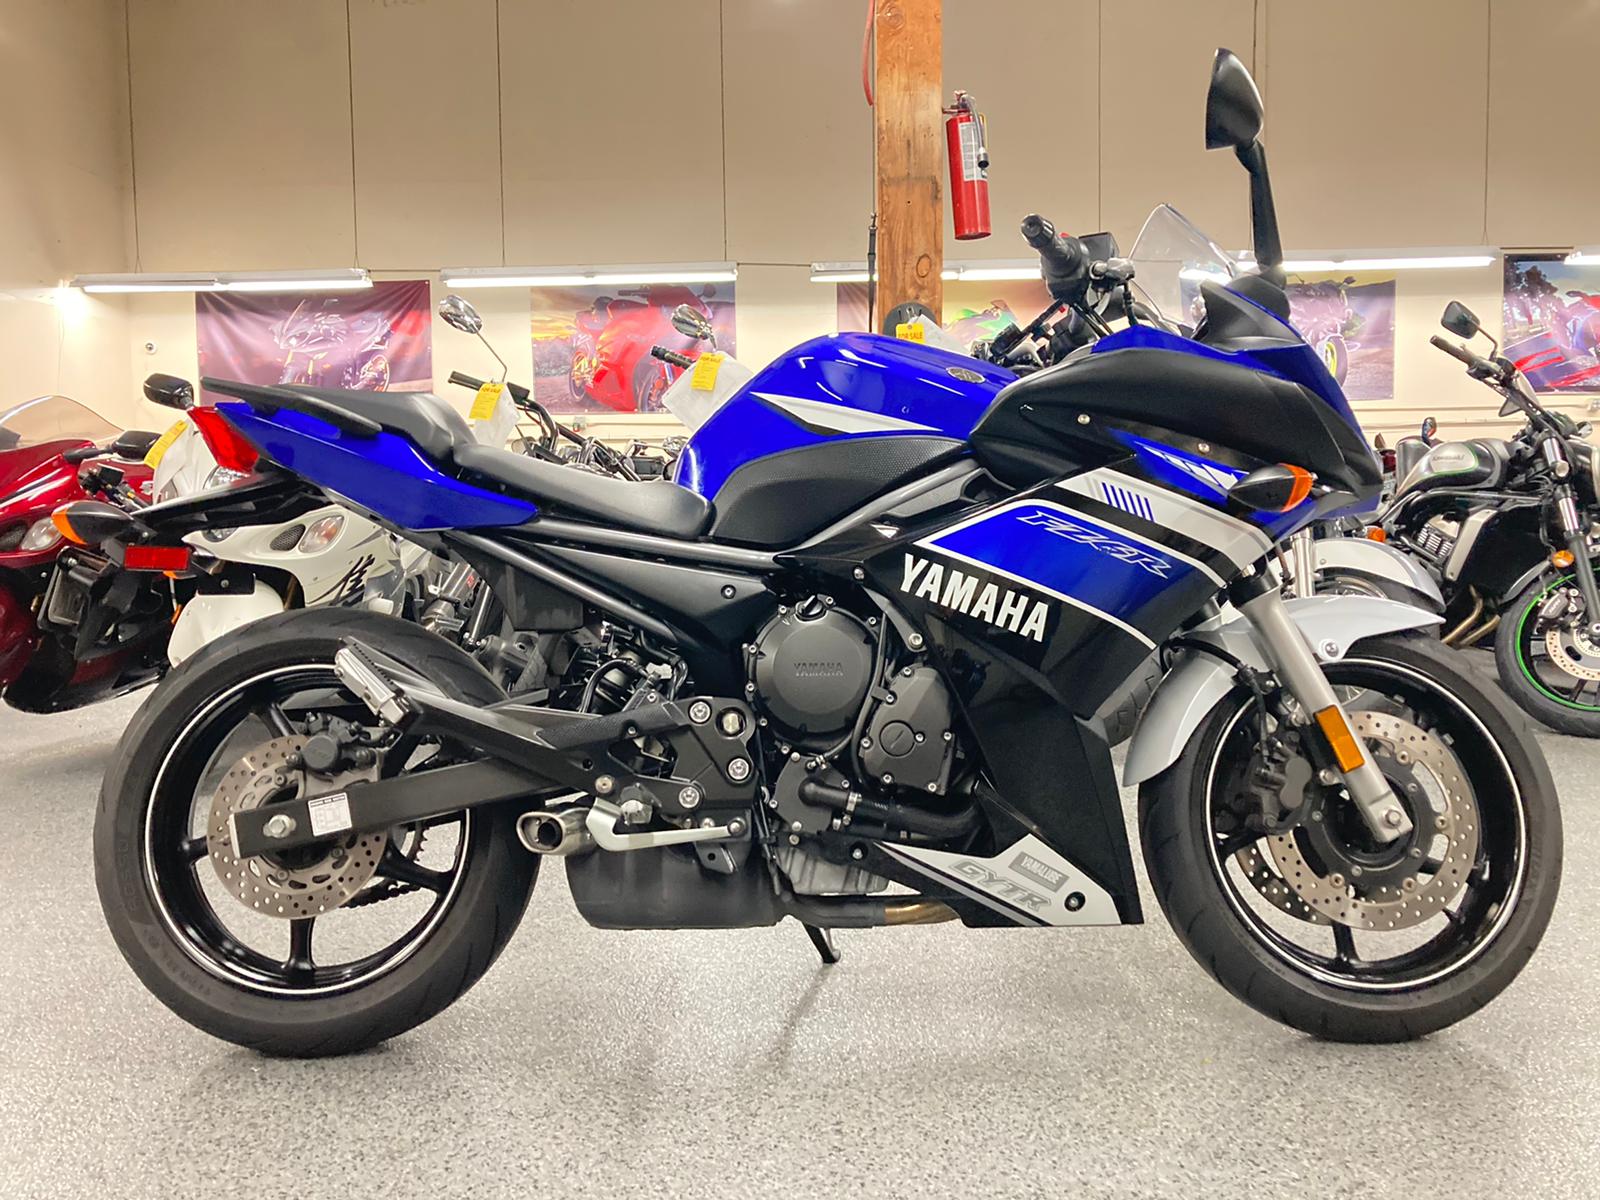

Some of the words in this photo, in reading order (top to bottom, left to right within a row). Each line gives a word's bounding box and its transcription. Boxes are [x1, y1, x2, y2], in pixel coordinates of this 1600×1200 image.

[900, 552, 1049, 643] YAMAHA
[793, 661, 845, 677] YAMAHA
[949, 859, 1051, 911] GYTR
